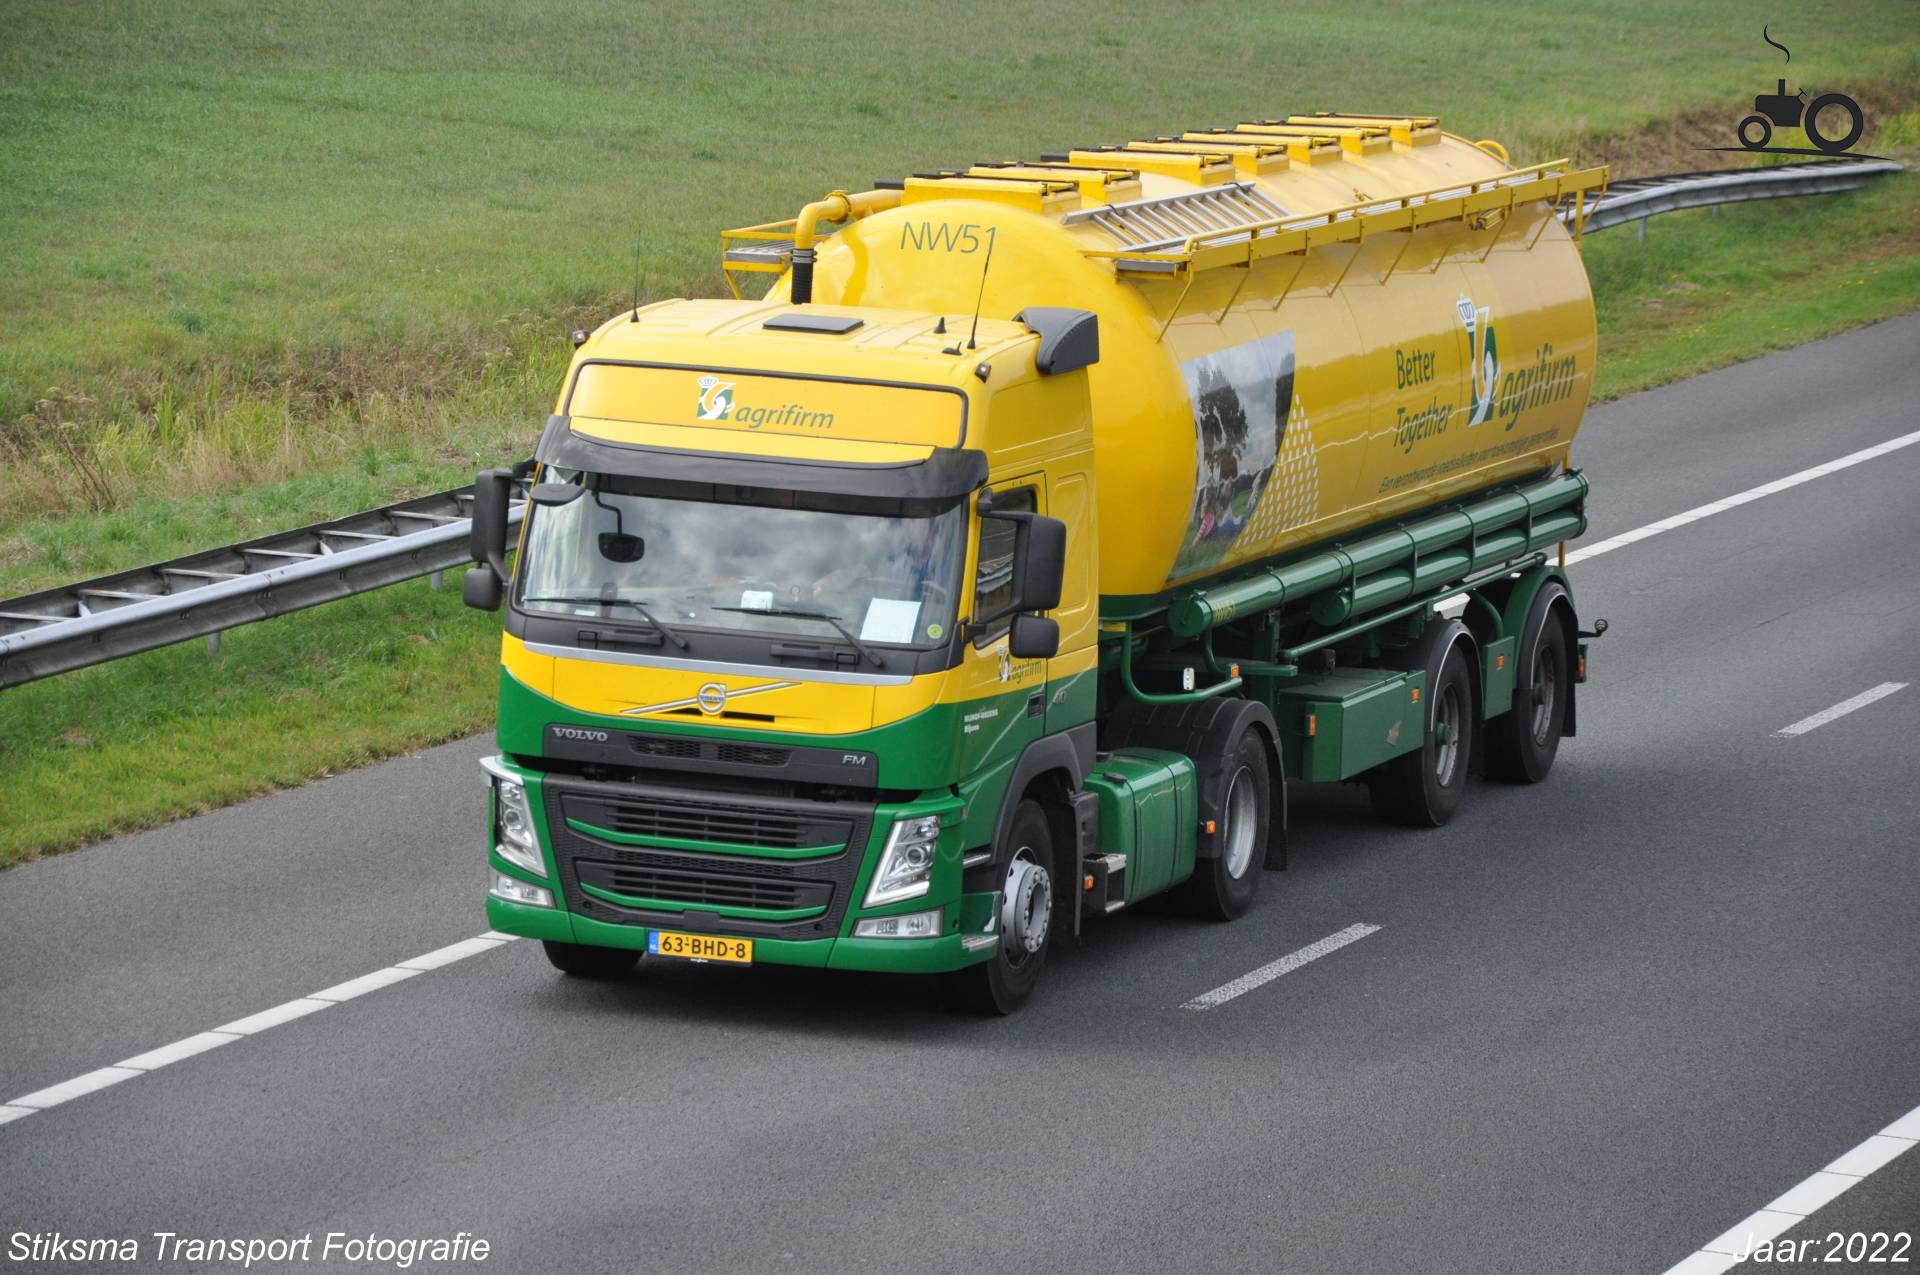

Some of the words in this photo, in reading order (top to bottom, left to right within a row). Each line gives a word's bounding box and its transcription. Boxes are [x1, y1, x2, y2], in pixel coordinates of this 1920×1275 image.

[900, 221, 996, 256] NW51
[1396, 349, 1435, 390] Better
[1499, 343, 1577, 432] agrifirm
[735, 404, 834, 429] agrifirm
[1394, 396, 1453, 454] Together
[552, 727, 608, 742] VOLVO
[843, 754, 867, 766] FM
